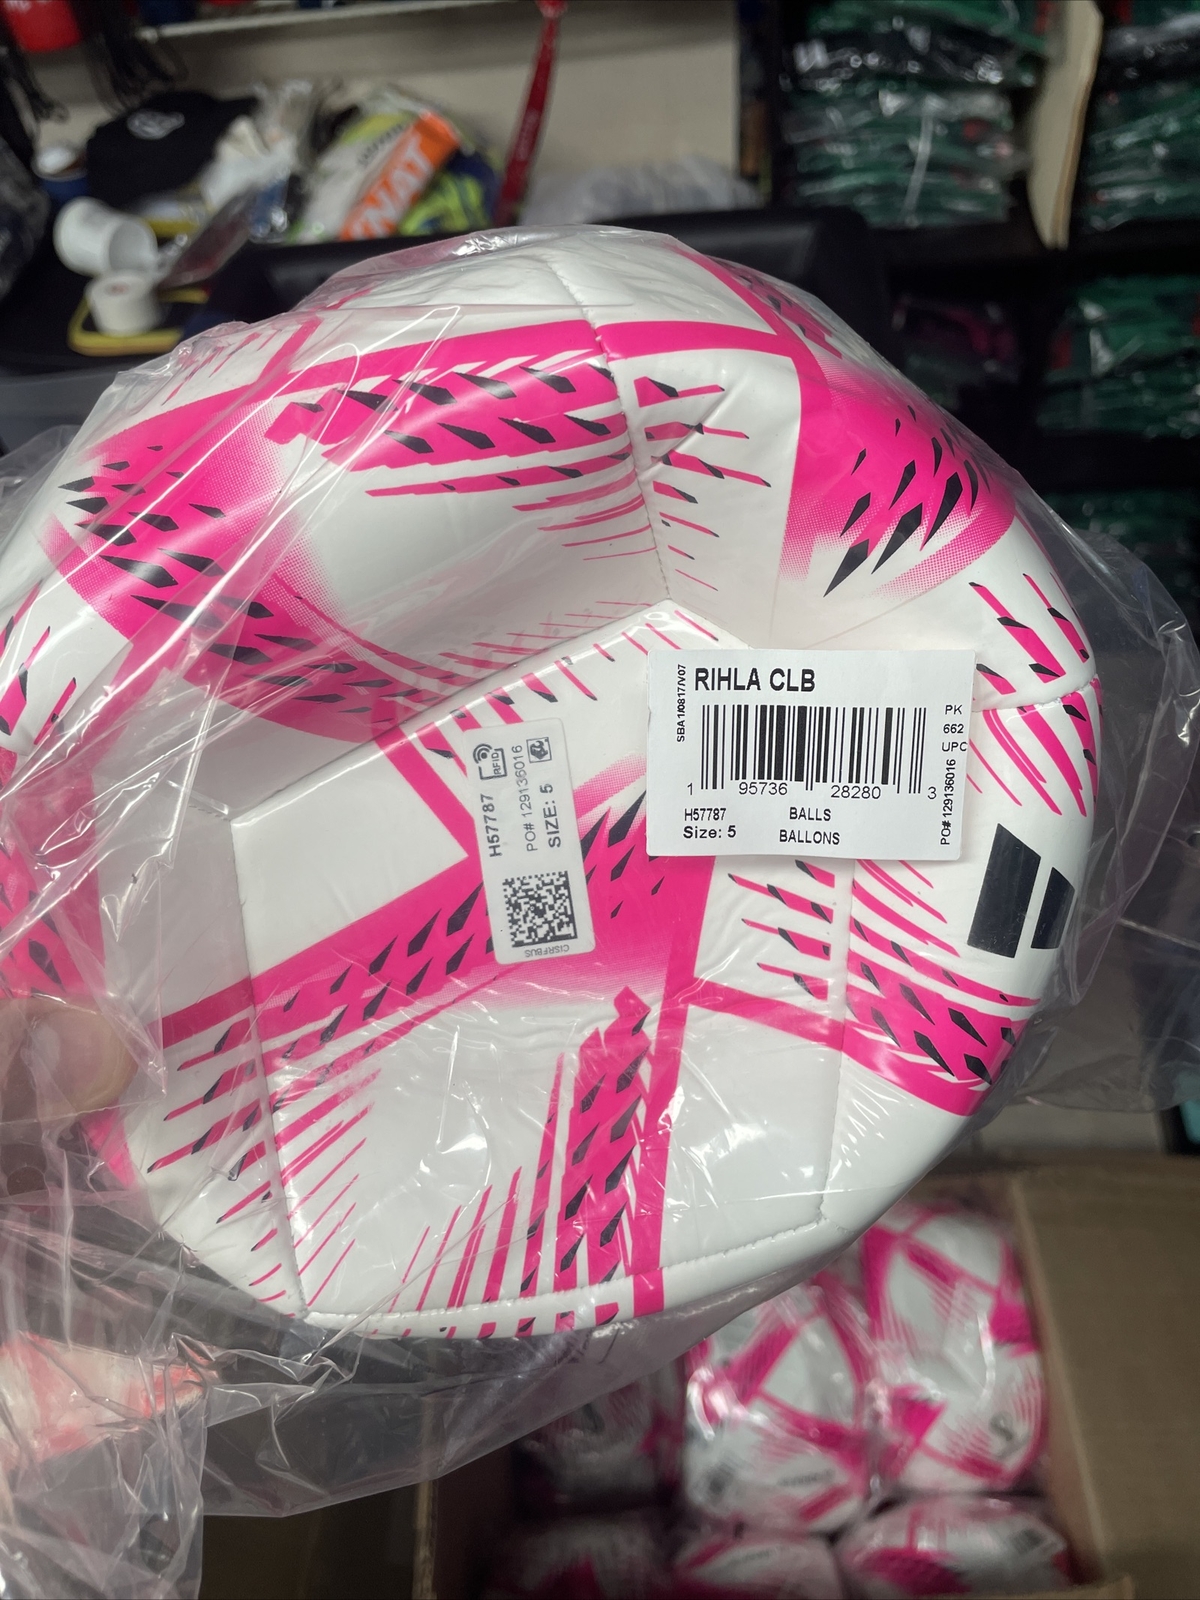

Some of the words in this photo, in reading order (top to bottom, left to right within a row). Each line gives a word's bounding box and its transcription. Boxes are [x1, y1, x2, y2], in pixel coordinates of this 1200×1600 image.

[694, 667, 762, 692] RIHLA
[769, 668, 817, 693] CLB
[944, 704, 963, 716] PK
[943, 724, 965, 735] 662
[941, 741, 968, 753] UPC
[491, 752, 501, 775] RFID
[511, 745, 534, 818] 129136016
[540, 783, 554, 794] 5
[942, 758, 957, 818] 129136016
[686, 783, 694, 796] 1
[738, 782, 788, 796] 95736
[830, 784, 882, 800] 28280
[928, 788, 937, 801] 3
[684, 807, 727, 822] H57787
[789, 806, 832, 822] BALLS
[480, 793, 503, 858] H57787
[543, 799, 562, 849] SIZE:
[682, 826, 723, 840] Size:
[727, 825, 737, 839] 5
[940, 821, 952, 846] PO#
[523, 822, 538, 852] PO#
[779, 829, 841, 846] BALLONS
